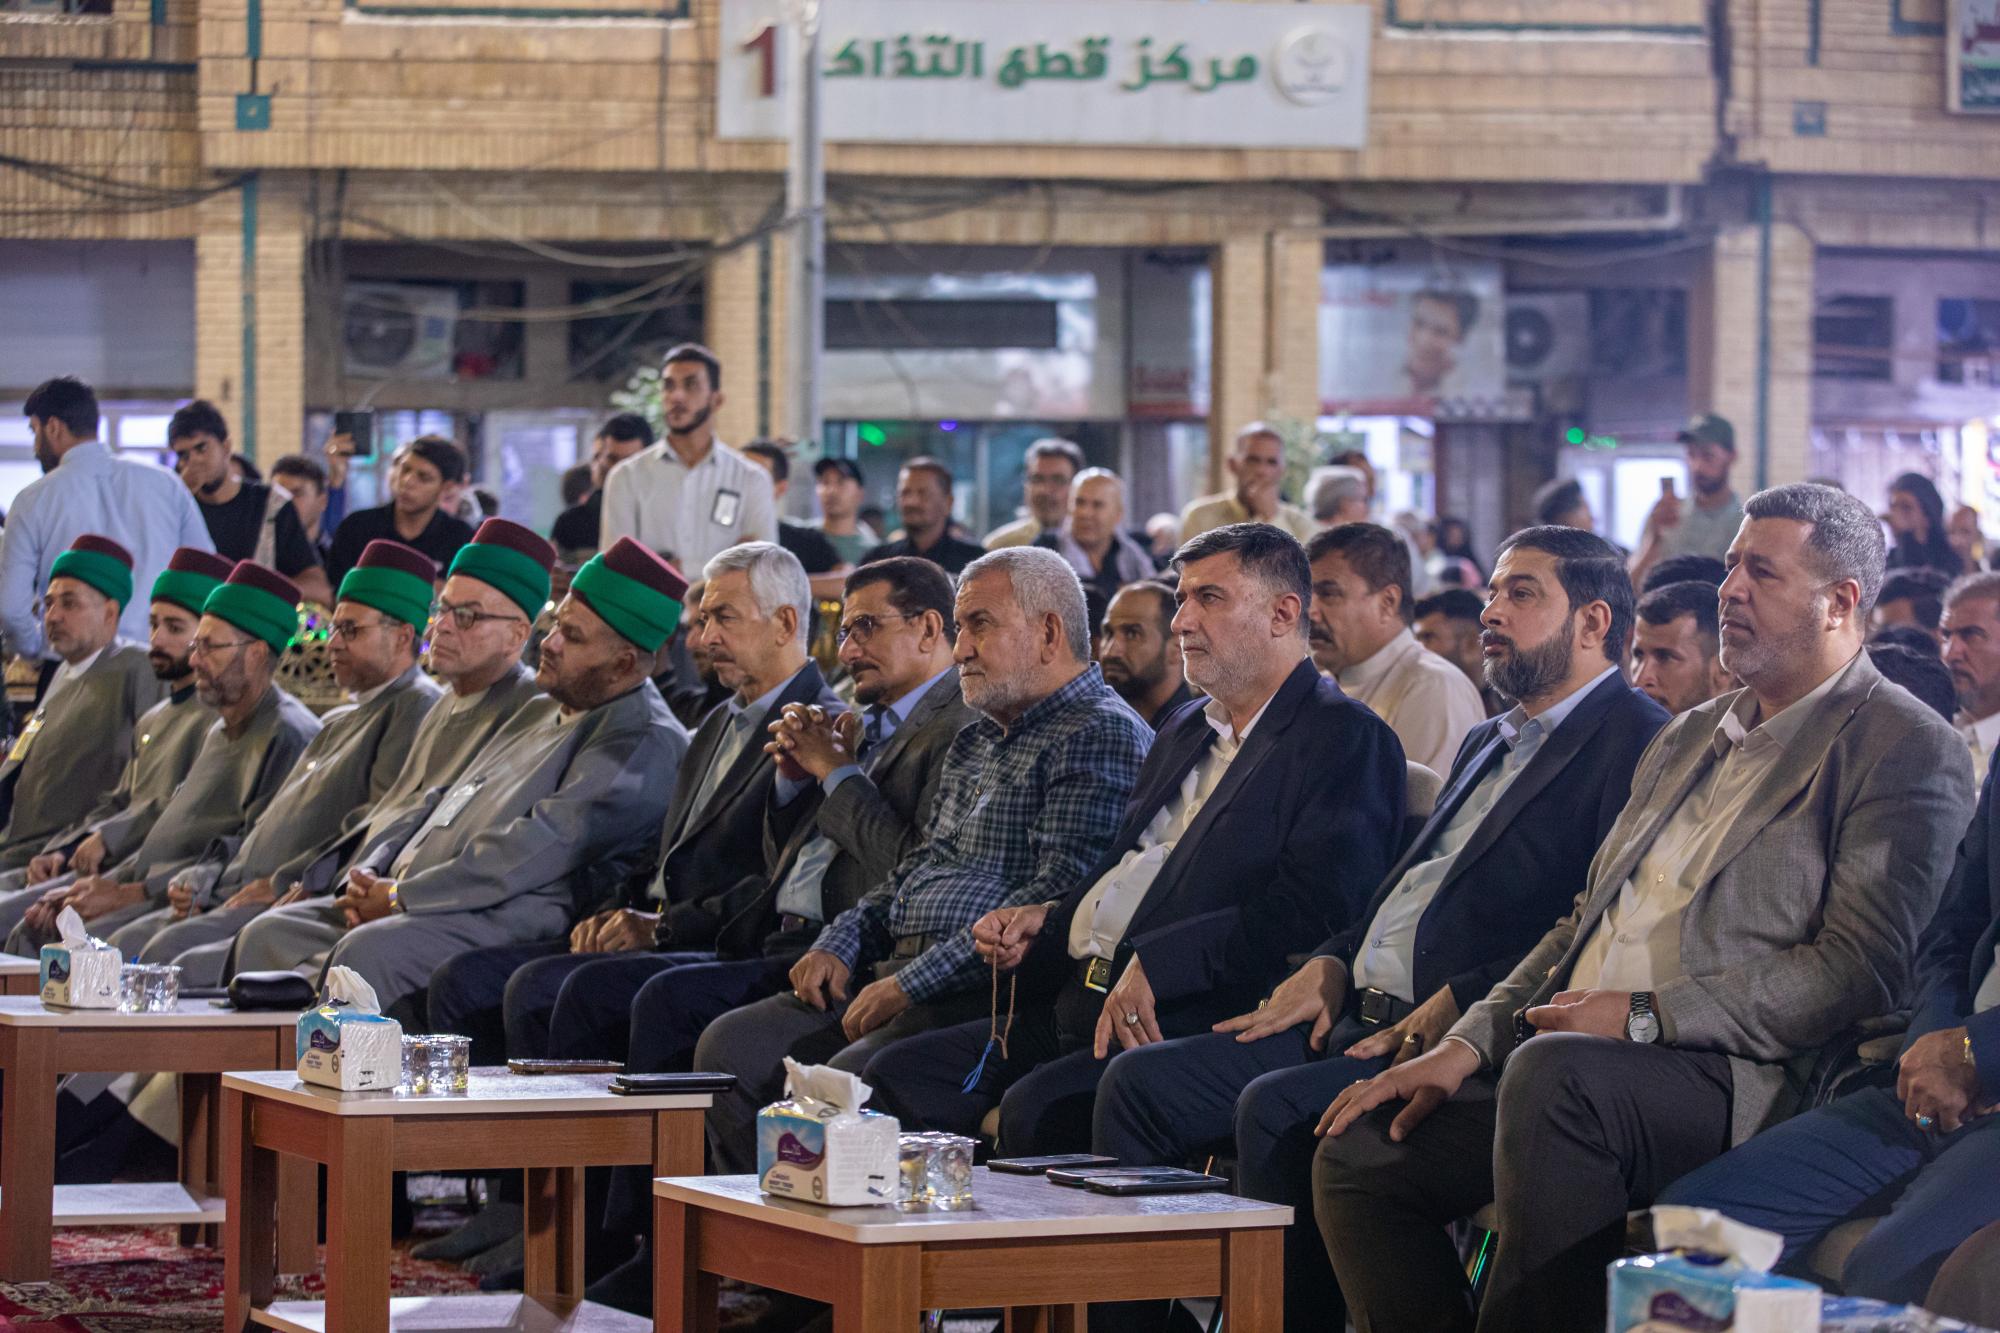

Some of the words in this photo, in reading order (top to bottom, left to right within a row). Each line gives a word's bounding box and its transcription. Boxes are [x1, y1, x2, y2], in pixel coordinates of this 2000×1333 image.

[740, 24, 777, 97] 1
[822, 34, 984, 79] التذاك
[997, 36, 1110, 88] قطع
[1118, 37, 1259, 92] مركز
